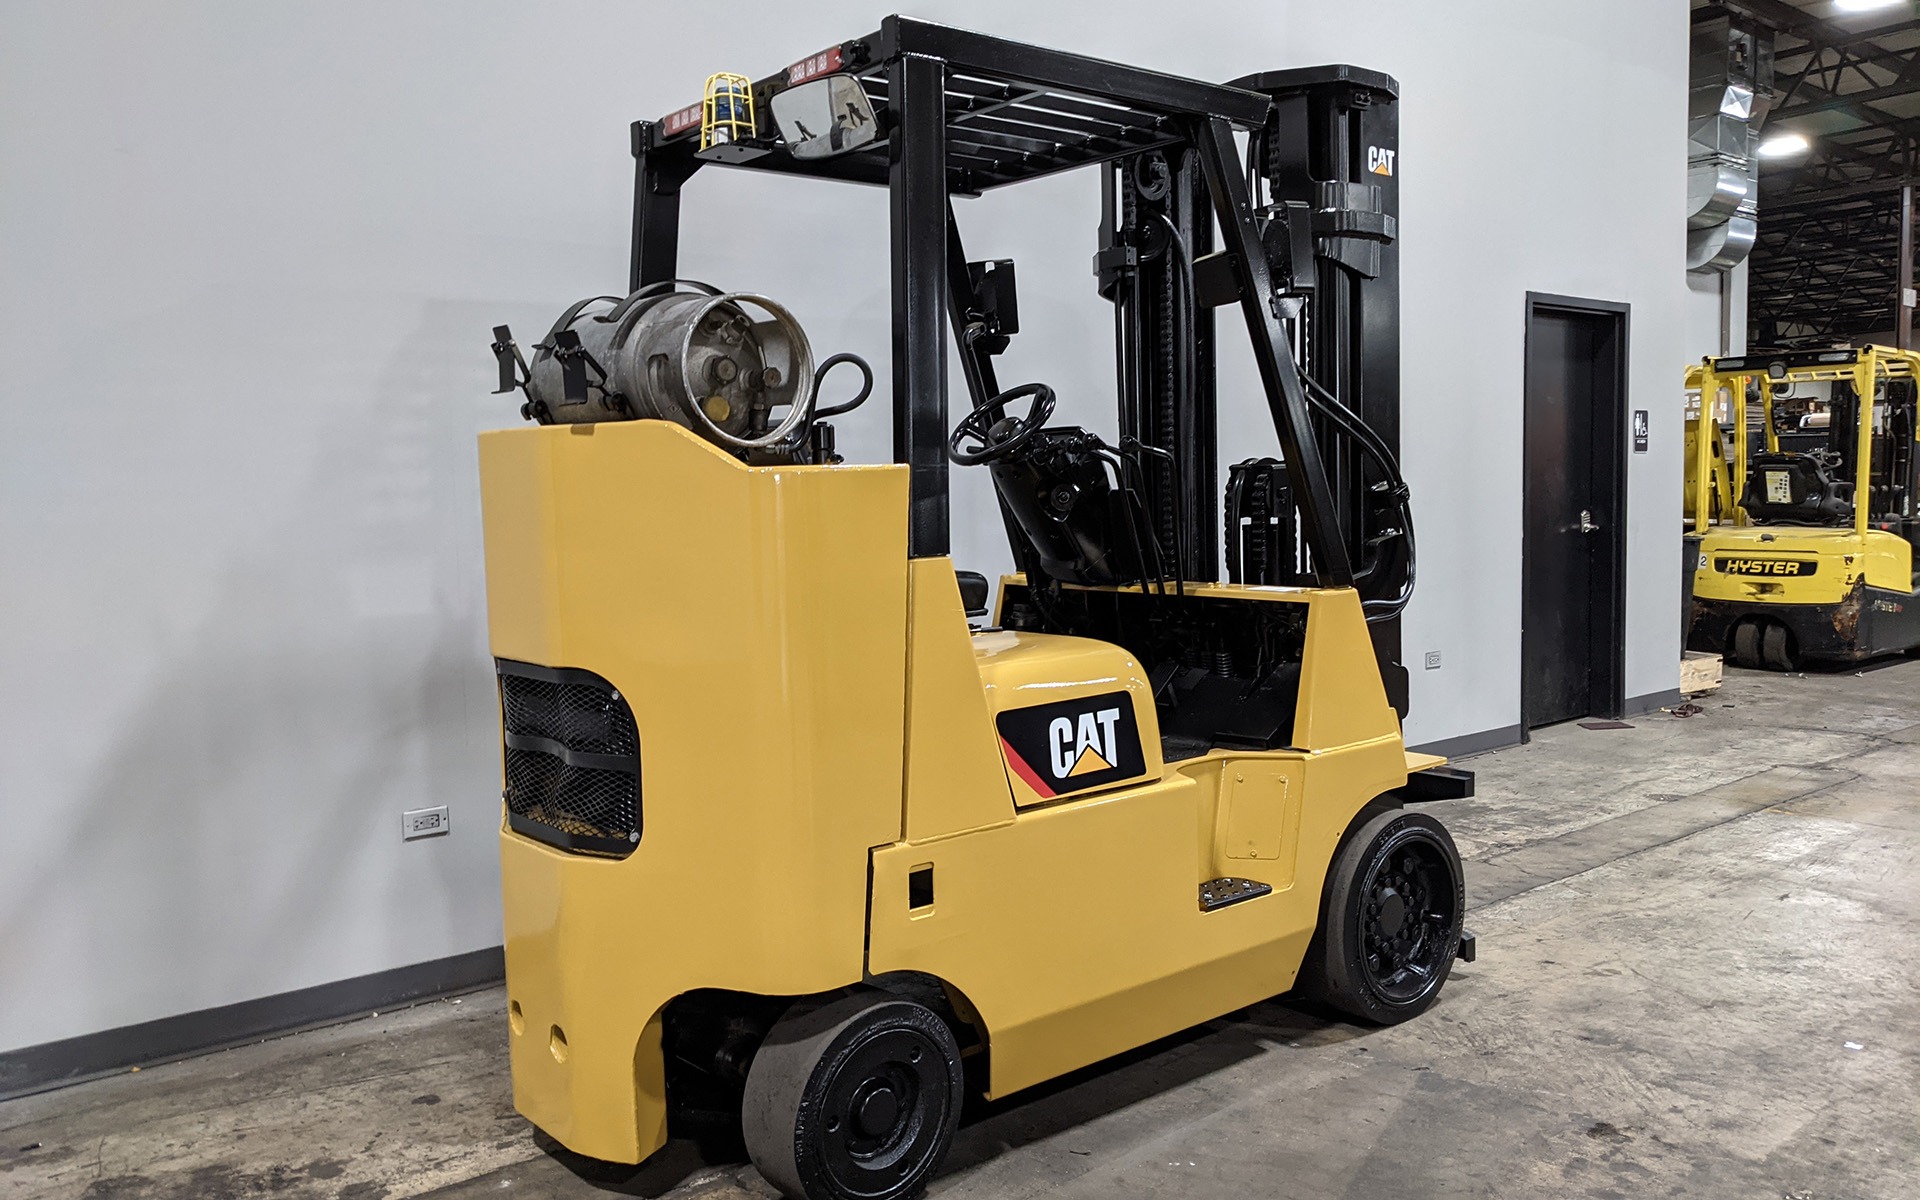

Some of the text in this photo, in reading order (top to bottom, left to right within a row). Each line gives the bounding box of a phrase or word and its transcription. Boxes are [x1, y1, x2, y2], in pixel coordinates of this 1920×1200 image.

[1368, 145, 1395, 177] CAT
[1726, 560, 1800, 575] HYSTER
[1049, 708, 1120, 779] CAT
